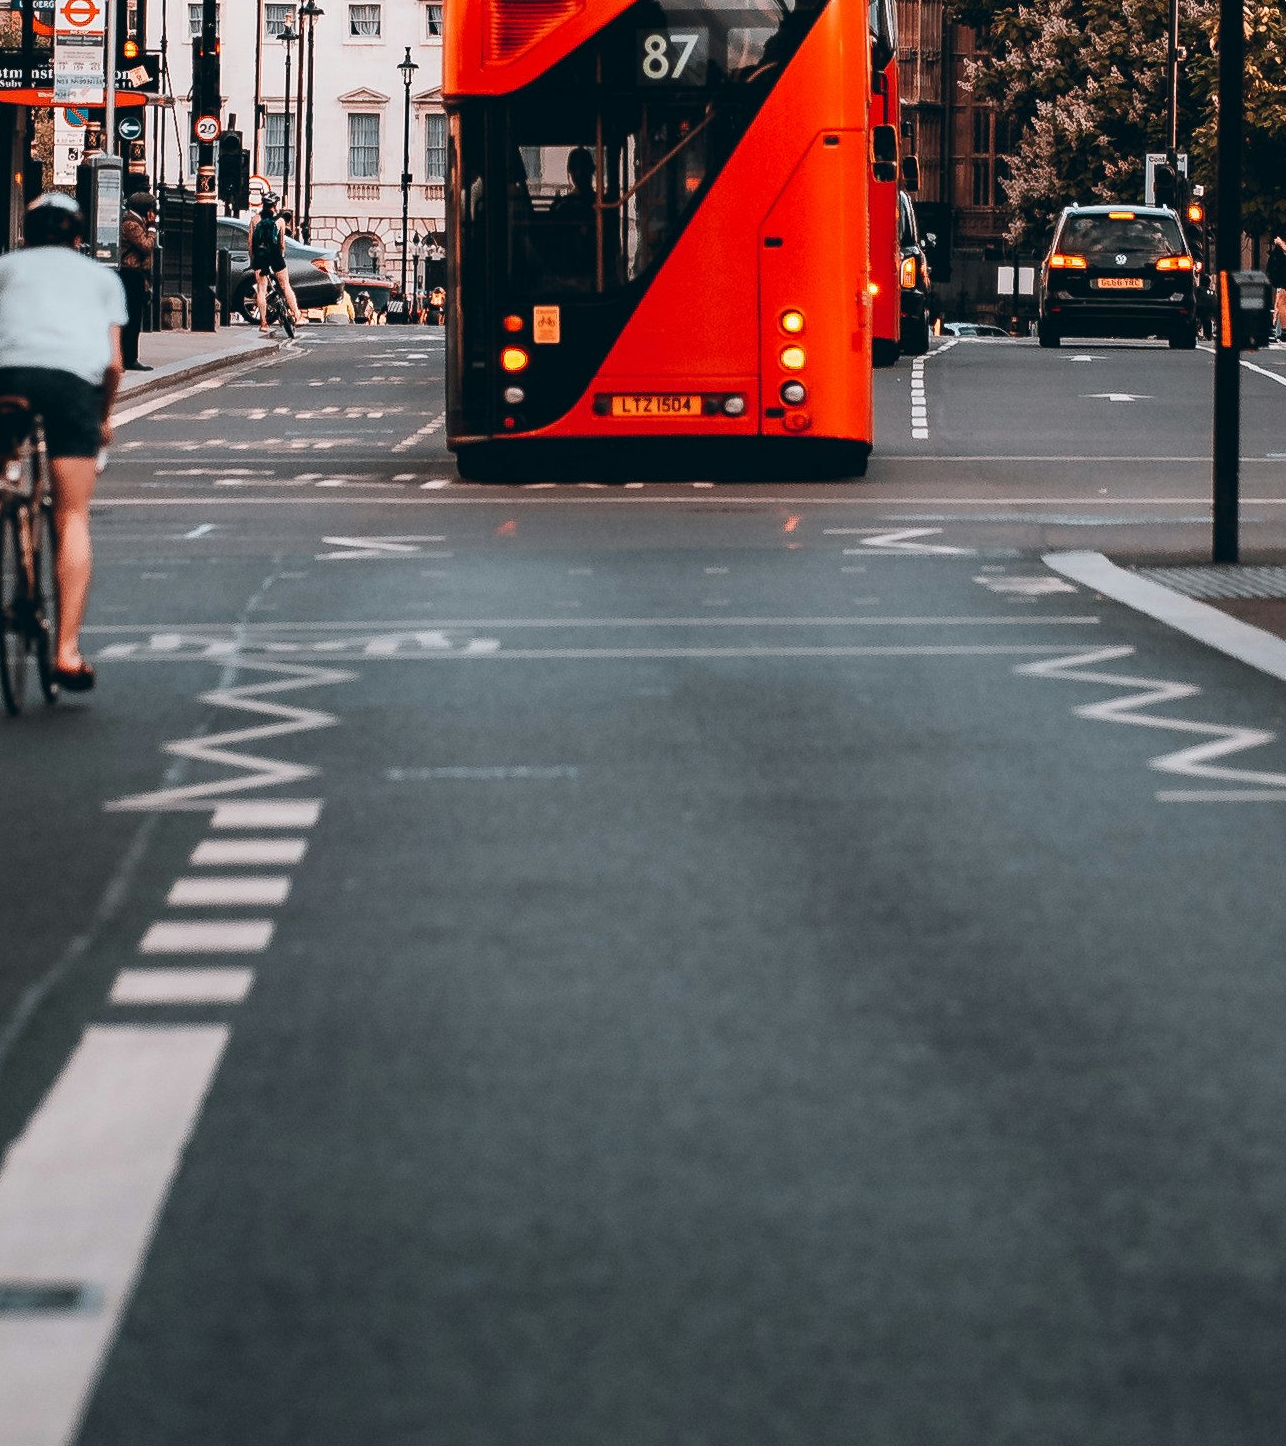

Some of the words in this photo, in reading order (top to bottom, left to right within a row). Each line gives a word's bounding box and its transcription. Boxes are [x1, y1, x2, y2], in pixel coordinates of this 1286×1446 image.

[642, 34, 699, 79] 87
[200, 124, 216, 134] 20
[622, 397, 653, 413] LTZ
[656, 397, 691, 413] 1504
